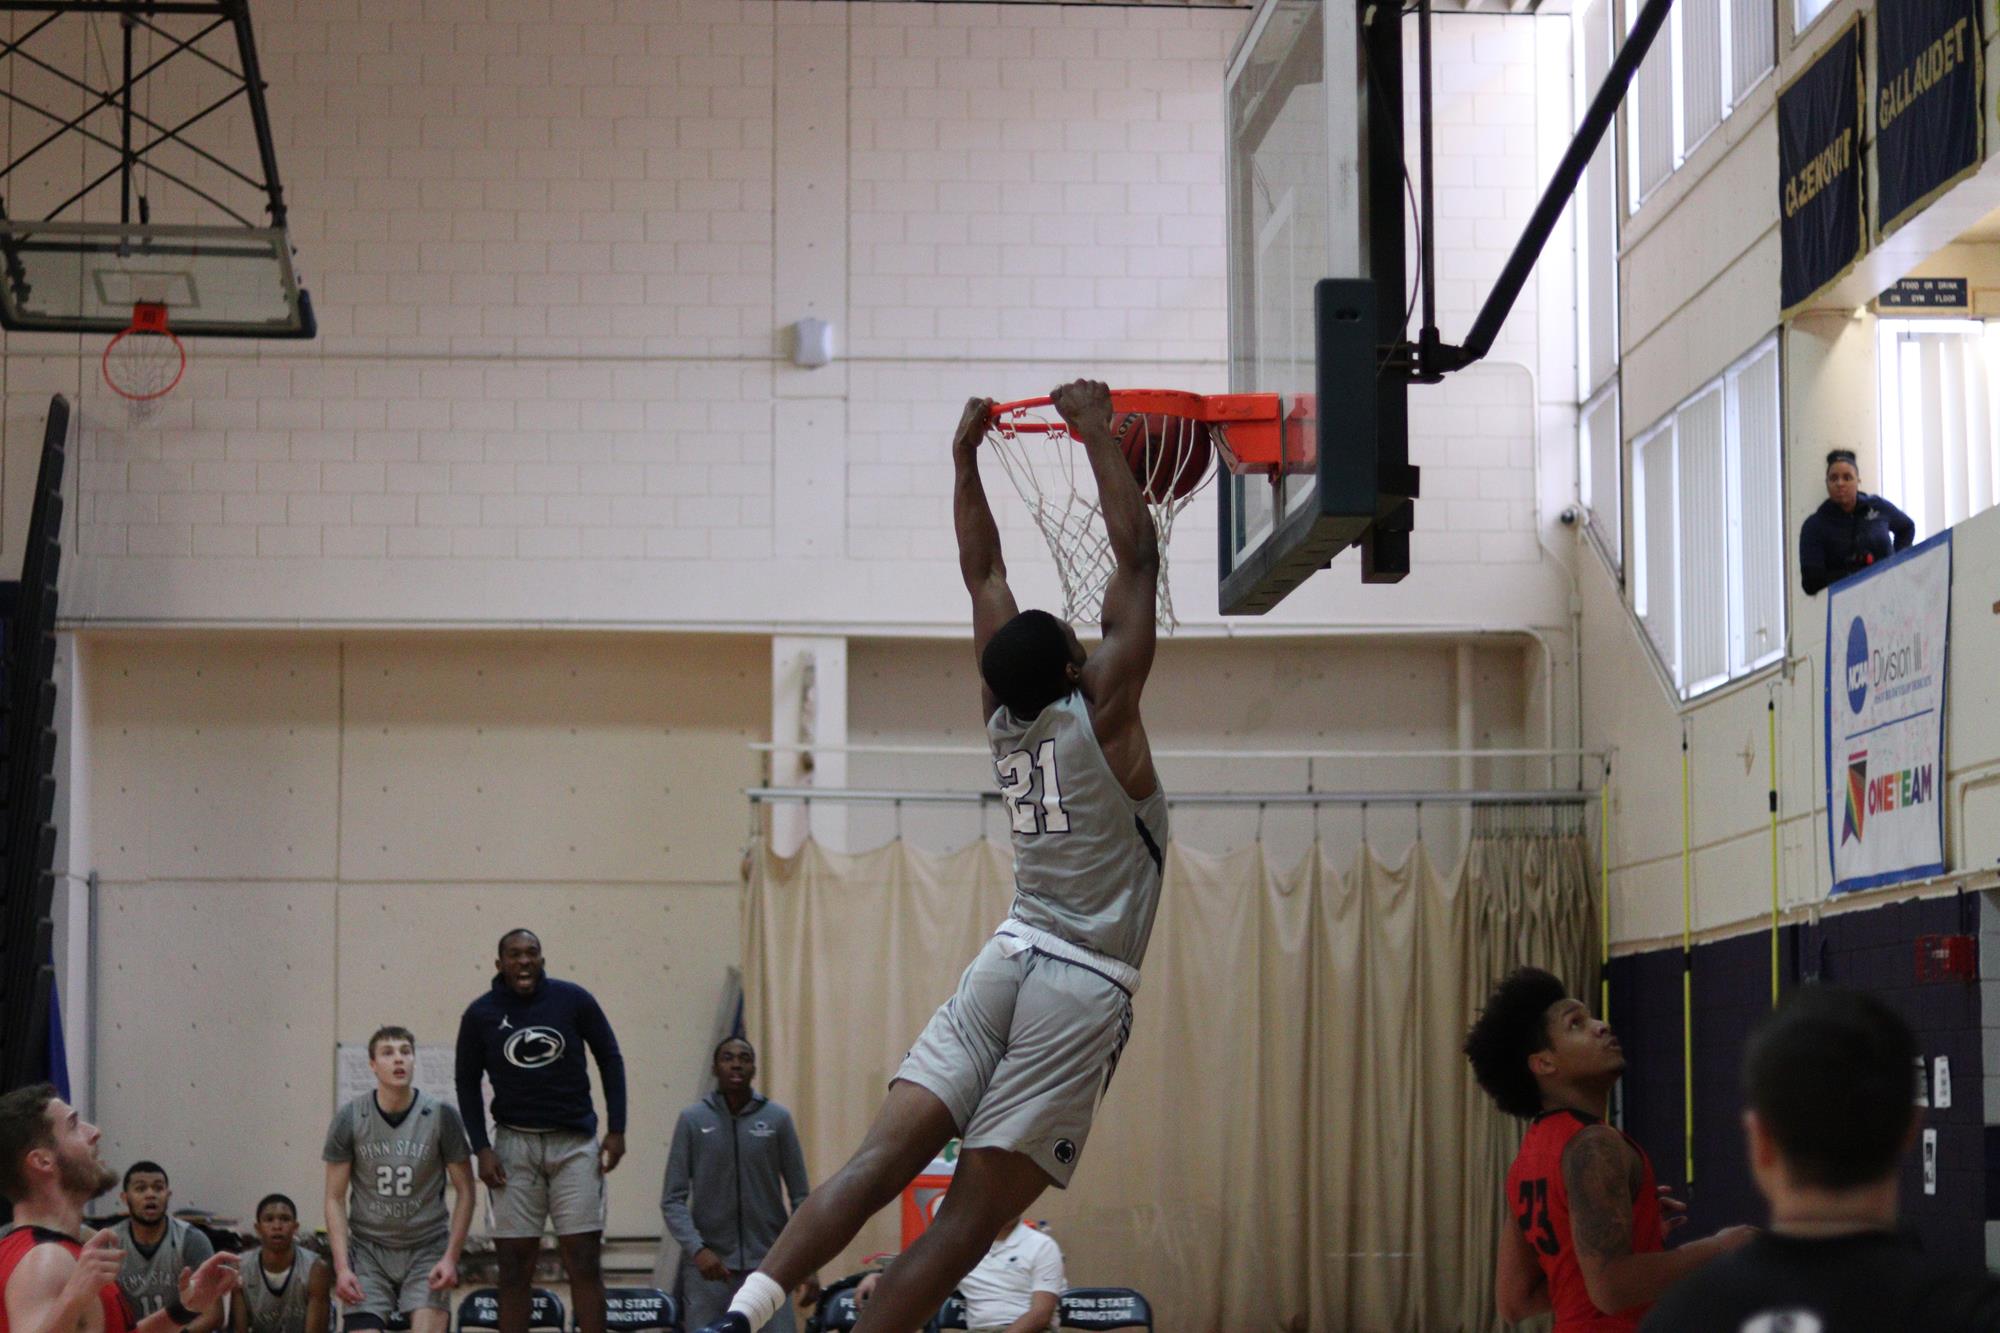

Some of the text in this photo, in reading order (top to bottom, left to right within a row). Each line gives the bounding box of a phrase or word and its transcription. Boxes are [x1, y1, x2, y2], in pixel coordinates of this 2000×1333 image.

[1880, 17, 1968, 130] GALLAUDET
[1873, 641, 1911, 687] Division
[995, 738, 1071, 835] 21
[360, 1140, 431, 1161] PENN STATE
[376, 1165, 413, 1197] 22
[474, 1297, 498, 1308] PEN
[625, 1298, 662, 1309] STATE
[840, 1298, 856, 1308] PE
[1062, 1297, 1136, 1308] PENN STATE
[1068, 1310, 1132, 1320] ABINGTON
